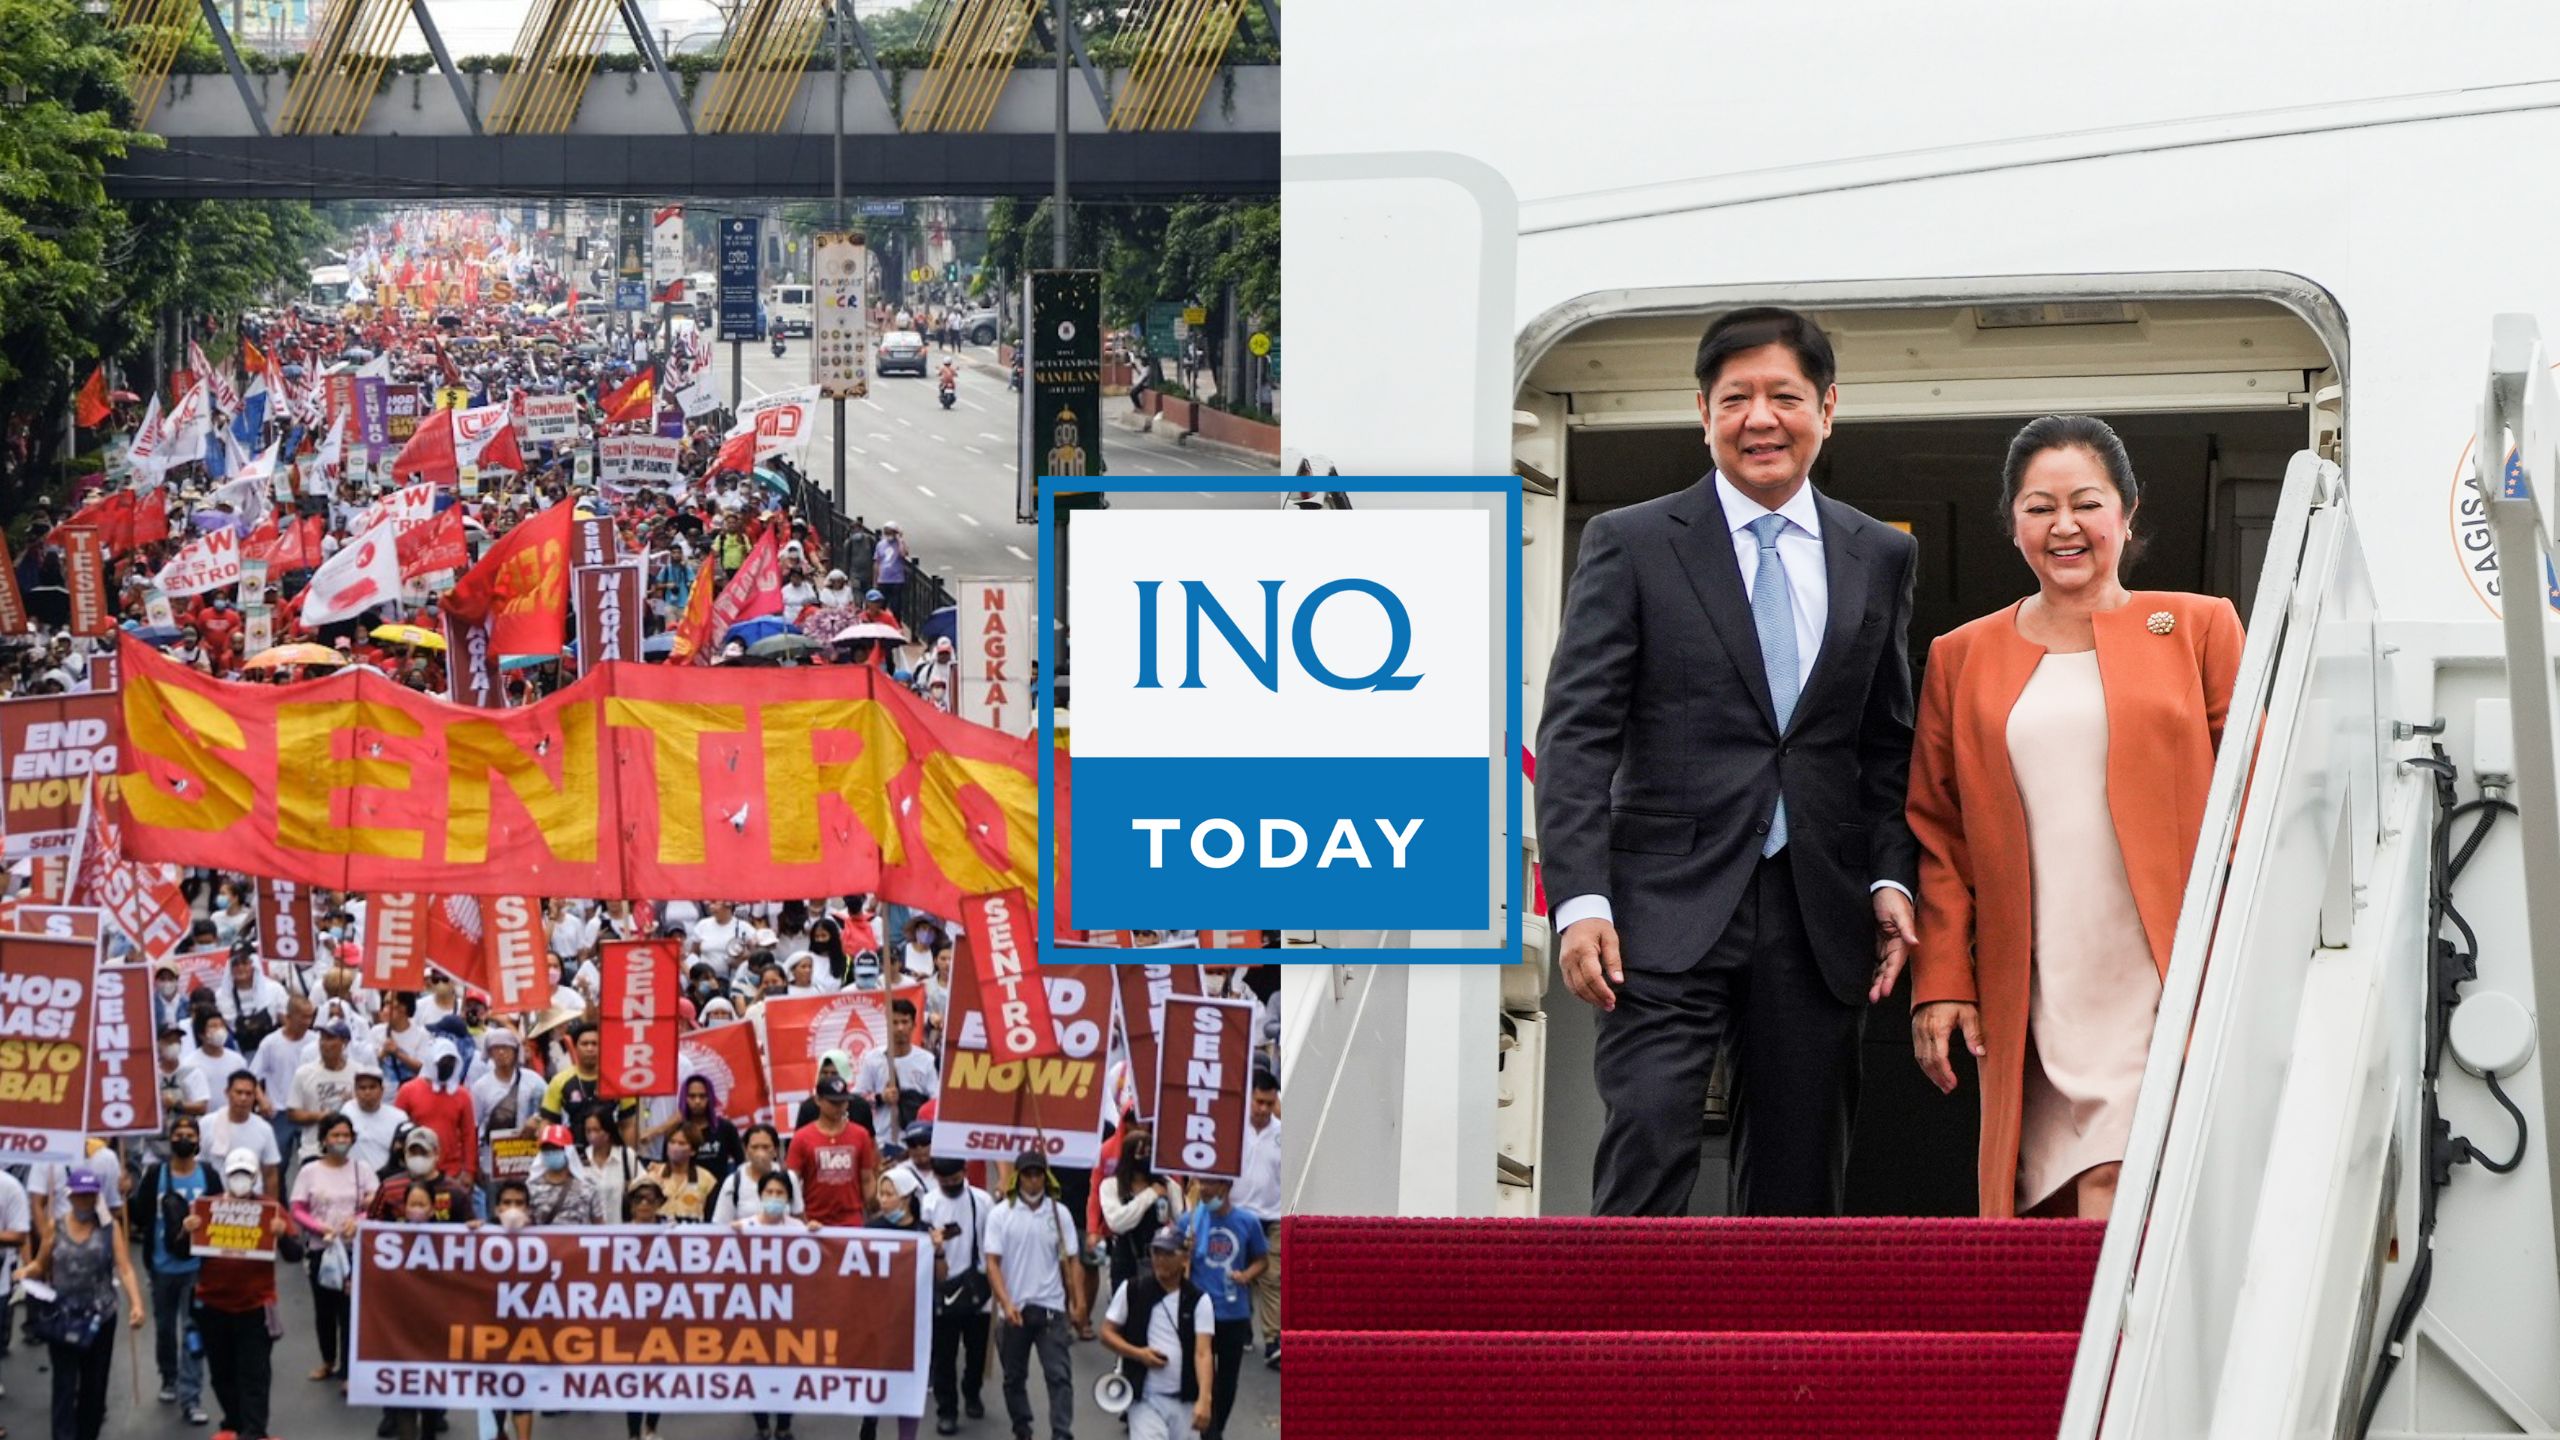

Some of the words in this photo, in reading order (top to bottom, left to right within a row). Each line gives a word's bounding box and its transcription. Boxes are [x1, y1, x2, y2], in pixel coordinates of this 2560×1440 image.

[70, 532, 98, 632] TESEF
[164, 563, 240, 591] SENTRO
[25, 719, 107, 751] END
[12, 746, 118, 780] ENDO
[114, 675, 1060, 910] SENTRO
[984, 898, 1037, 1053] SENTRO
[0, 1005, 76, 1039] AS!
[619, 948, 656, 1090] SENTRO
[97, 972, 134, 1128] SENTRO
[949, 1052, 1095, 1099] NOW!
[1182, 1007, 1223, 1169] SENTRO
[966, 1130, 1065, 1154] SENTRO
[373, 1233, 563, 1280] SAHOD,
[579, 1235, 821, 1275] TRABAHO
[838, 1239, 901, 1278] AT
[496, 1281, 794, 1320] KARAPATAN
[448, 1324, 839, 1365] IPAGLABAN!
[375, 1368, 526, 1397] SENTRO
[562, 1372, 757, 1399] NAGKAISA
[794, 1375, 888, 1404] APTU
